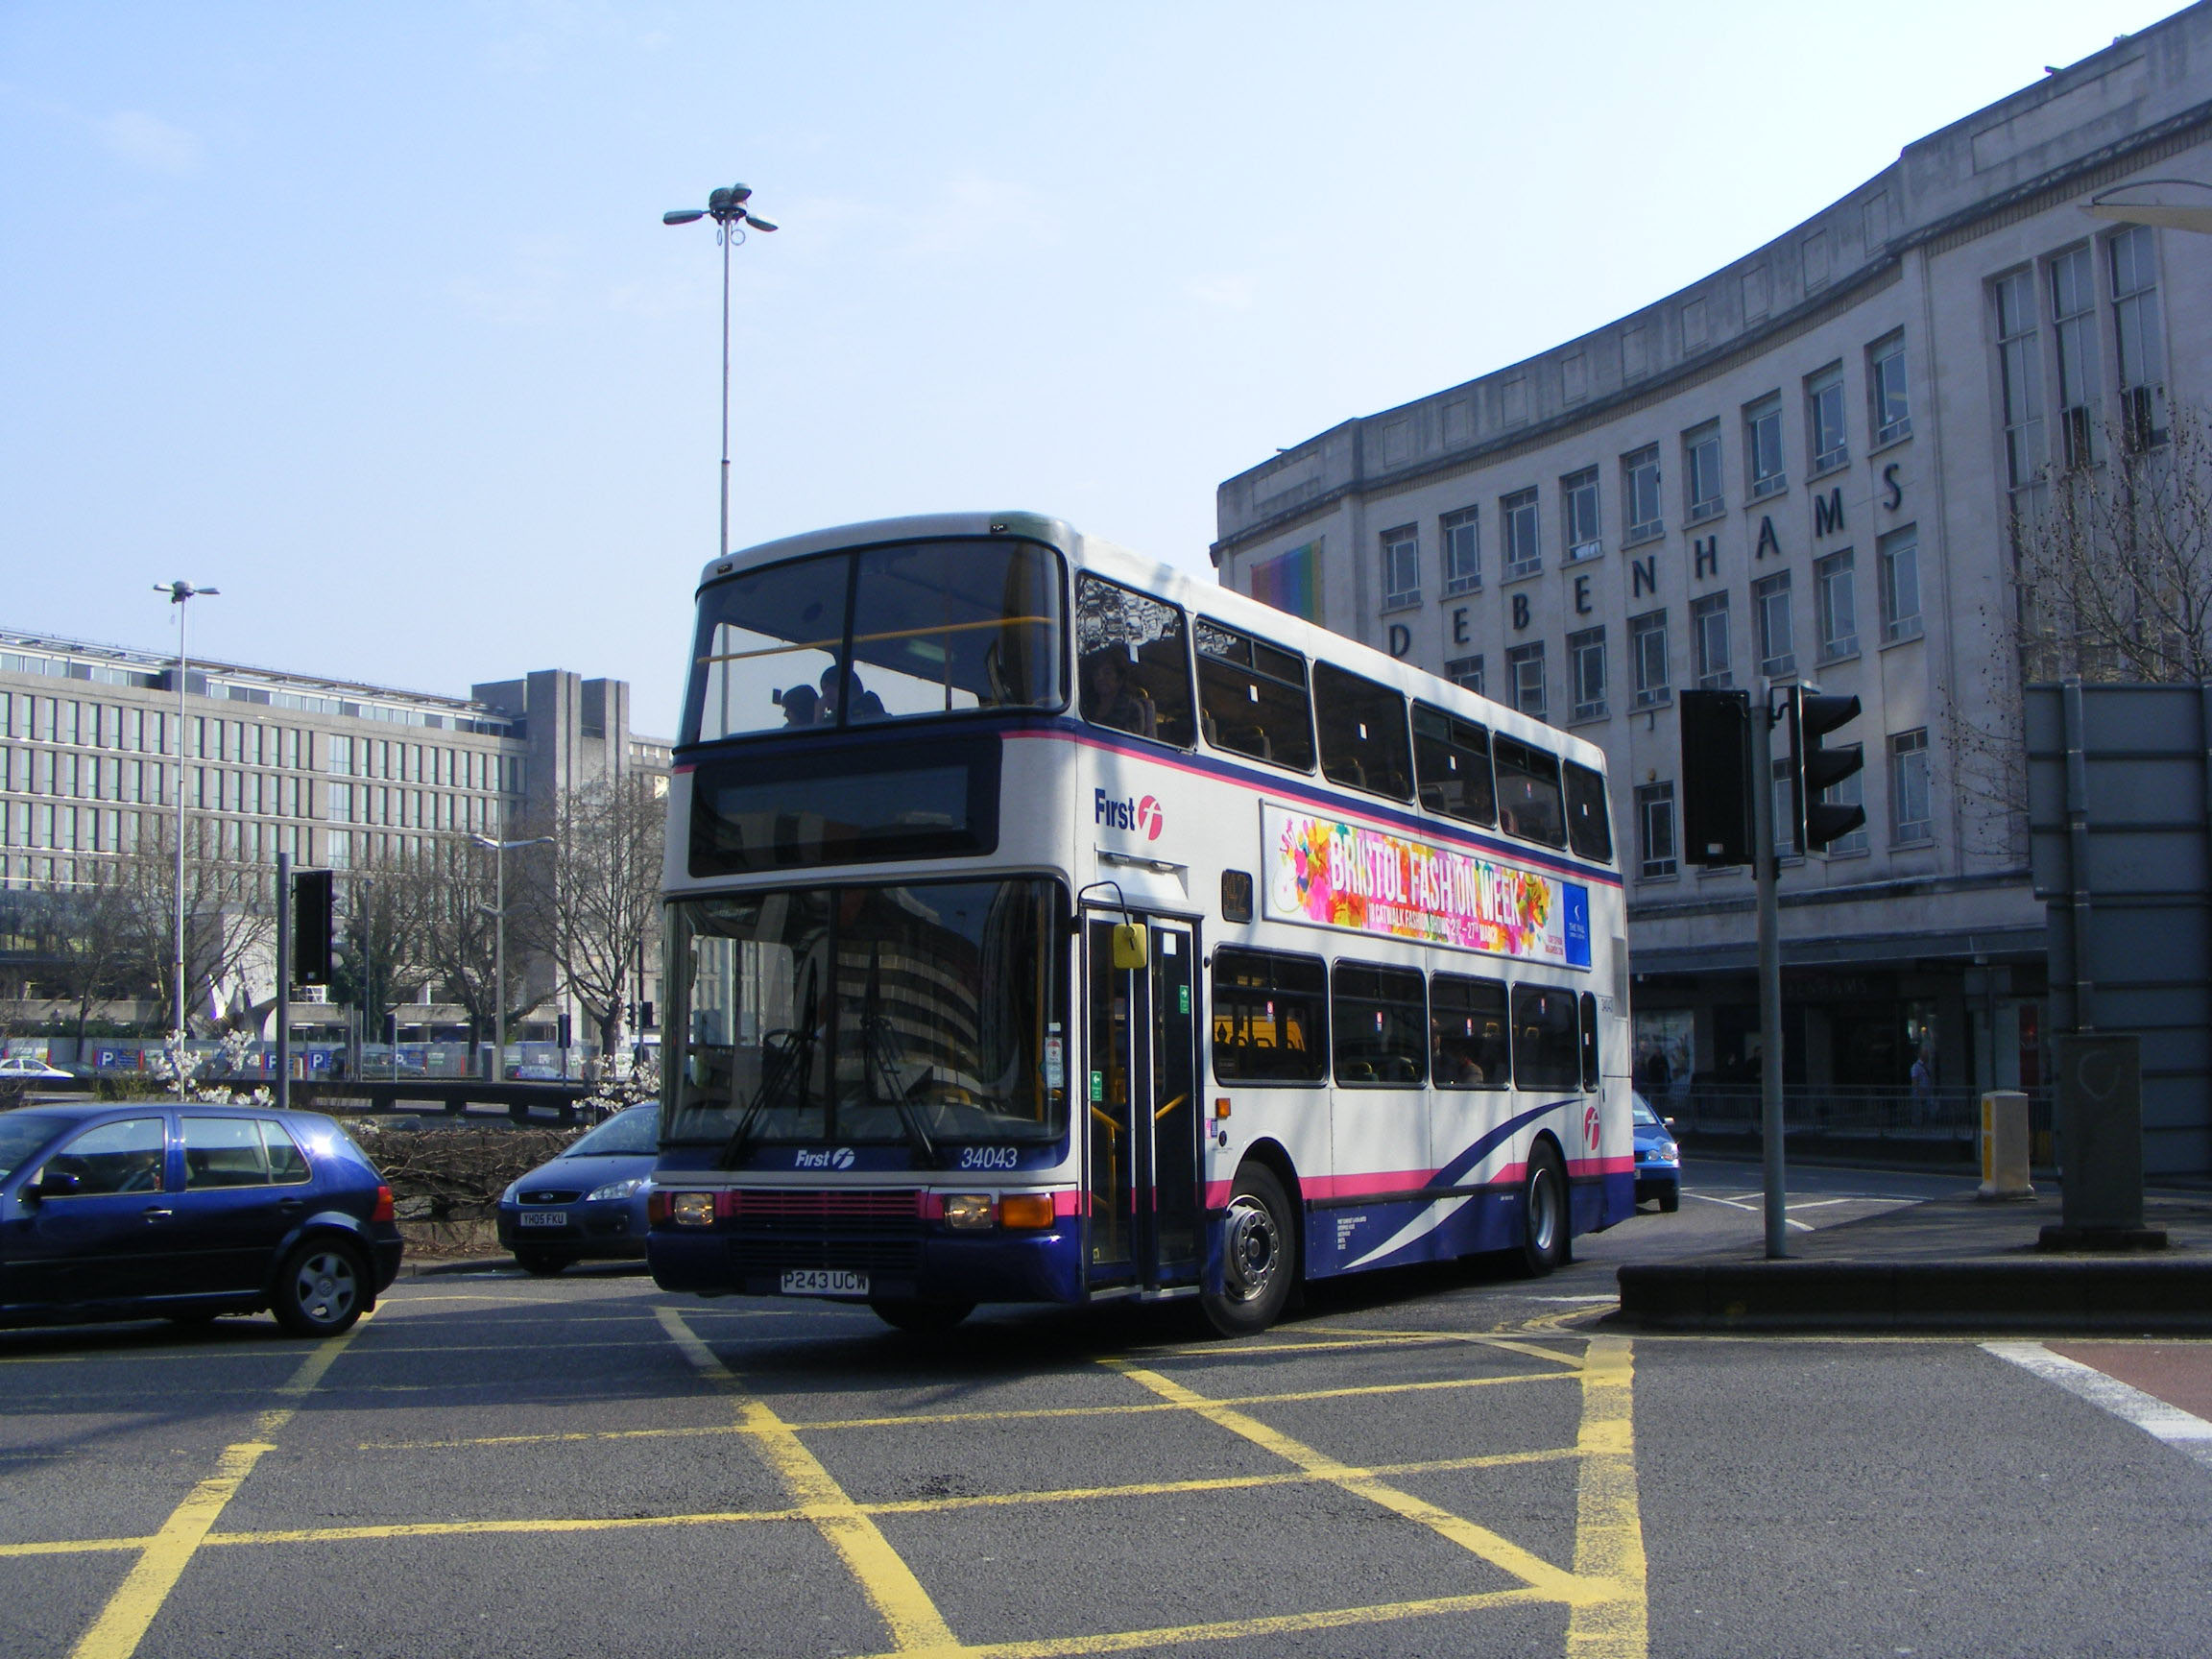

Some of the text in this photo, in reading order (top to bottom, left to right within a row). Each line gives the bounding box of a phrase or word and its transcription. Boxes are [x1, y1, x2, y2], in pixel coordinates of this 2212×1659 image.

[1389, 463, 1902, 659] DEBENHAMS
[1094, 787, 1135, 831] First
[1329, 830, 1522, 927] BRISTOL FASHION WEEK
[102, 1051, 114, 1067] P
[313, 1054, 324, 1068] P
[795, 1149, 830, 1166] First
[961, 1146, 1018, 1168] 34043
[547, 1214, 565, 1224] FKU
[783, 1272, 829, 1288] P243
